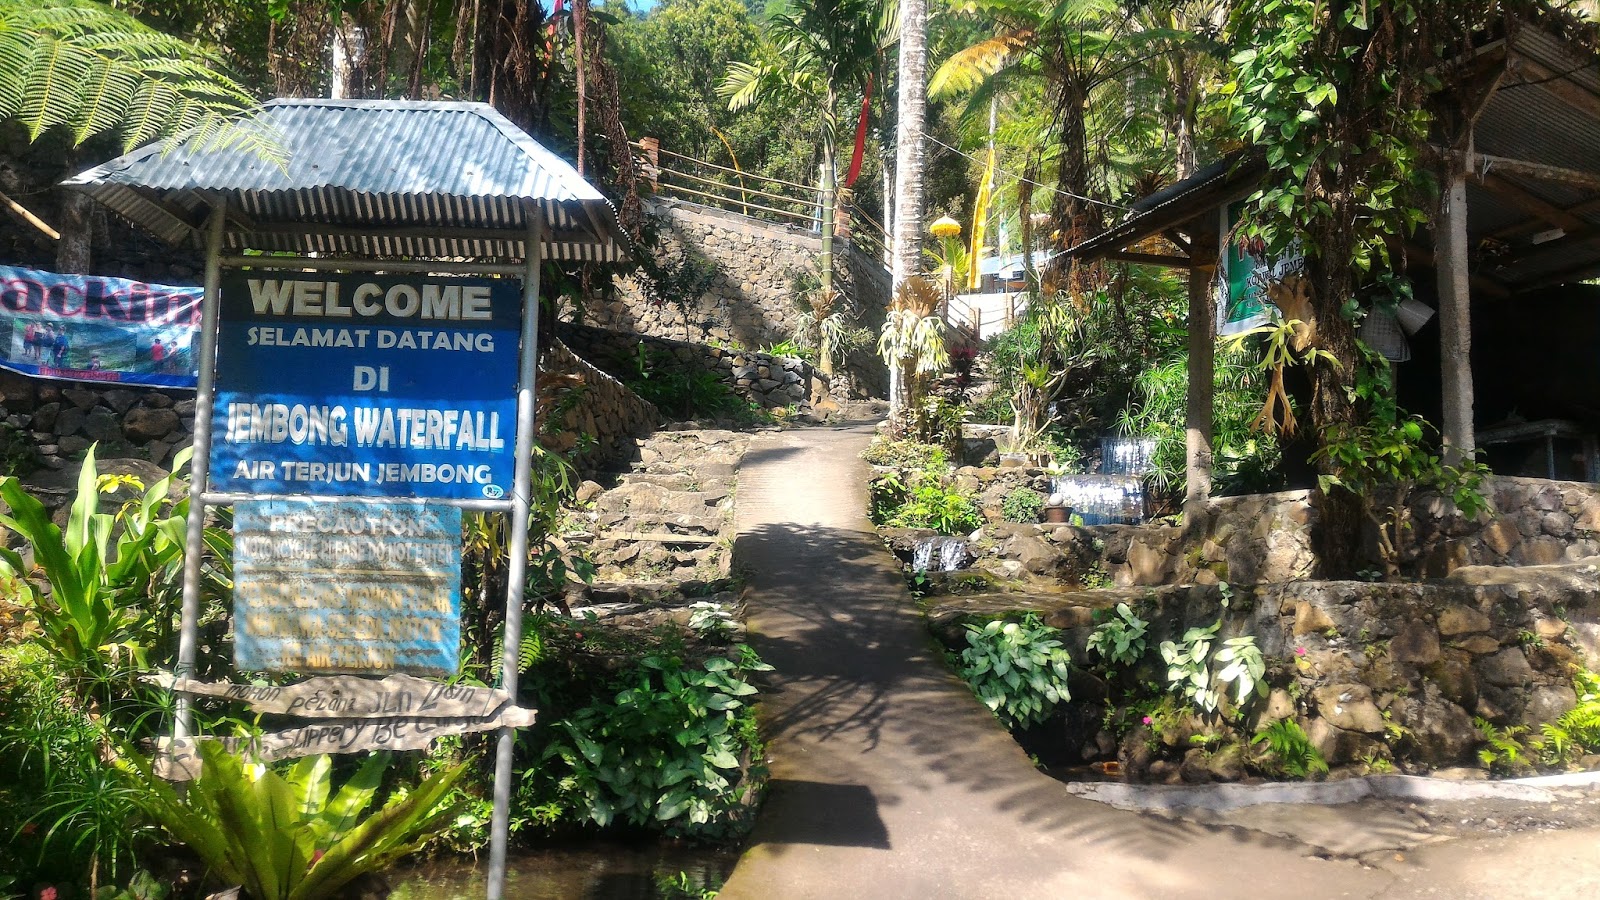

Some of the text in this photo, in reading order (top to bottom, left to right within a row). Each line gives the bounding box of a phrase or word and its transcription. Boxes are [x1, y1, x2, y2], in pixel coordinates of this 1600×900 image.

[0, 276, 204, 326] ackin
[248, 279, 493, 321] WELCOME
[247, 327, 495, 352] SELAMAT DATANG
[353, 365, 390, 392] DI
[224, 402, 504, 452] JEMBONG WATERFALL
[233, 459, 493, 485] AIR TERJUN JEMBONG
[240, 536, 318, 560] MOTORCYCLE
[367, 541, 385, 562] DO
[388, 541, 413, 563] NOT
